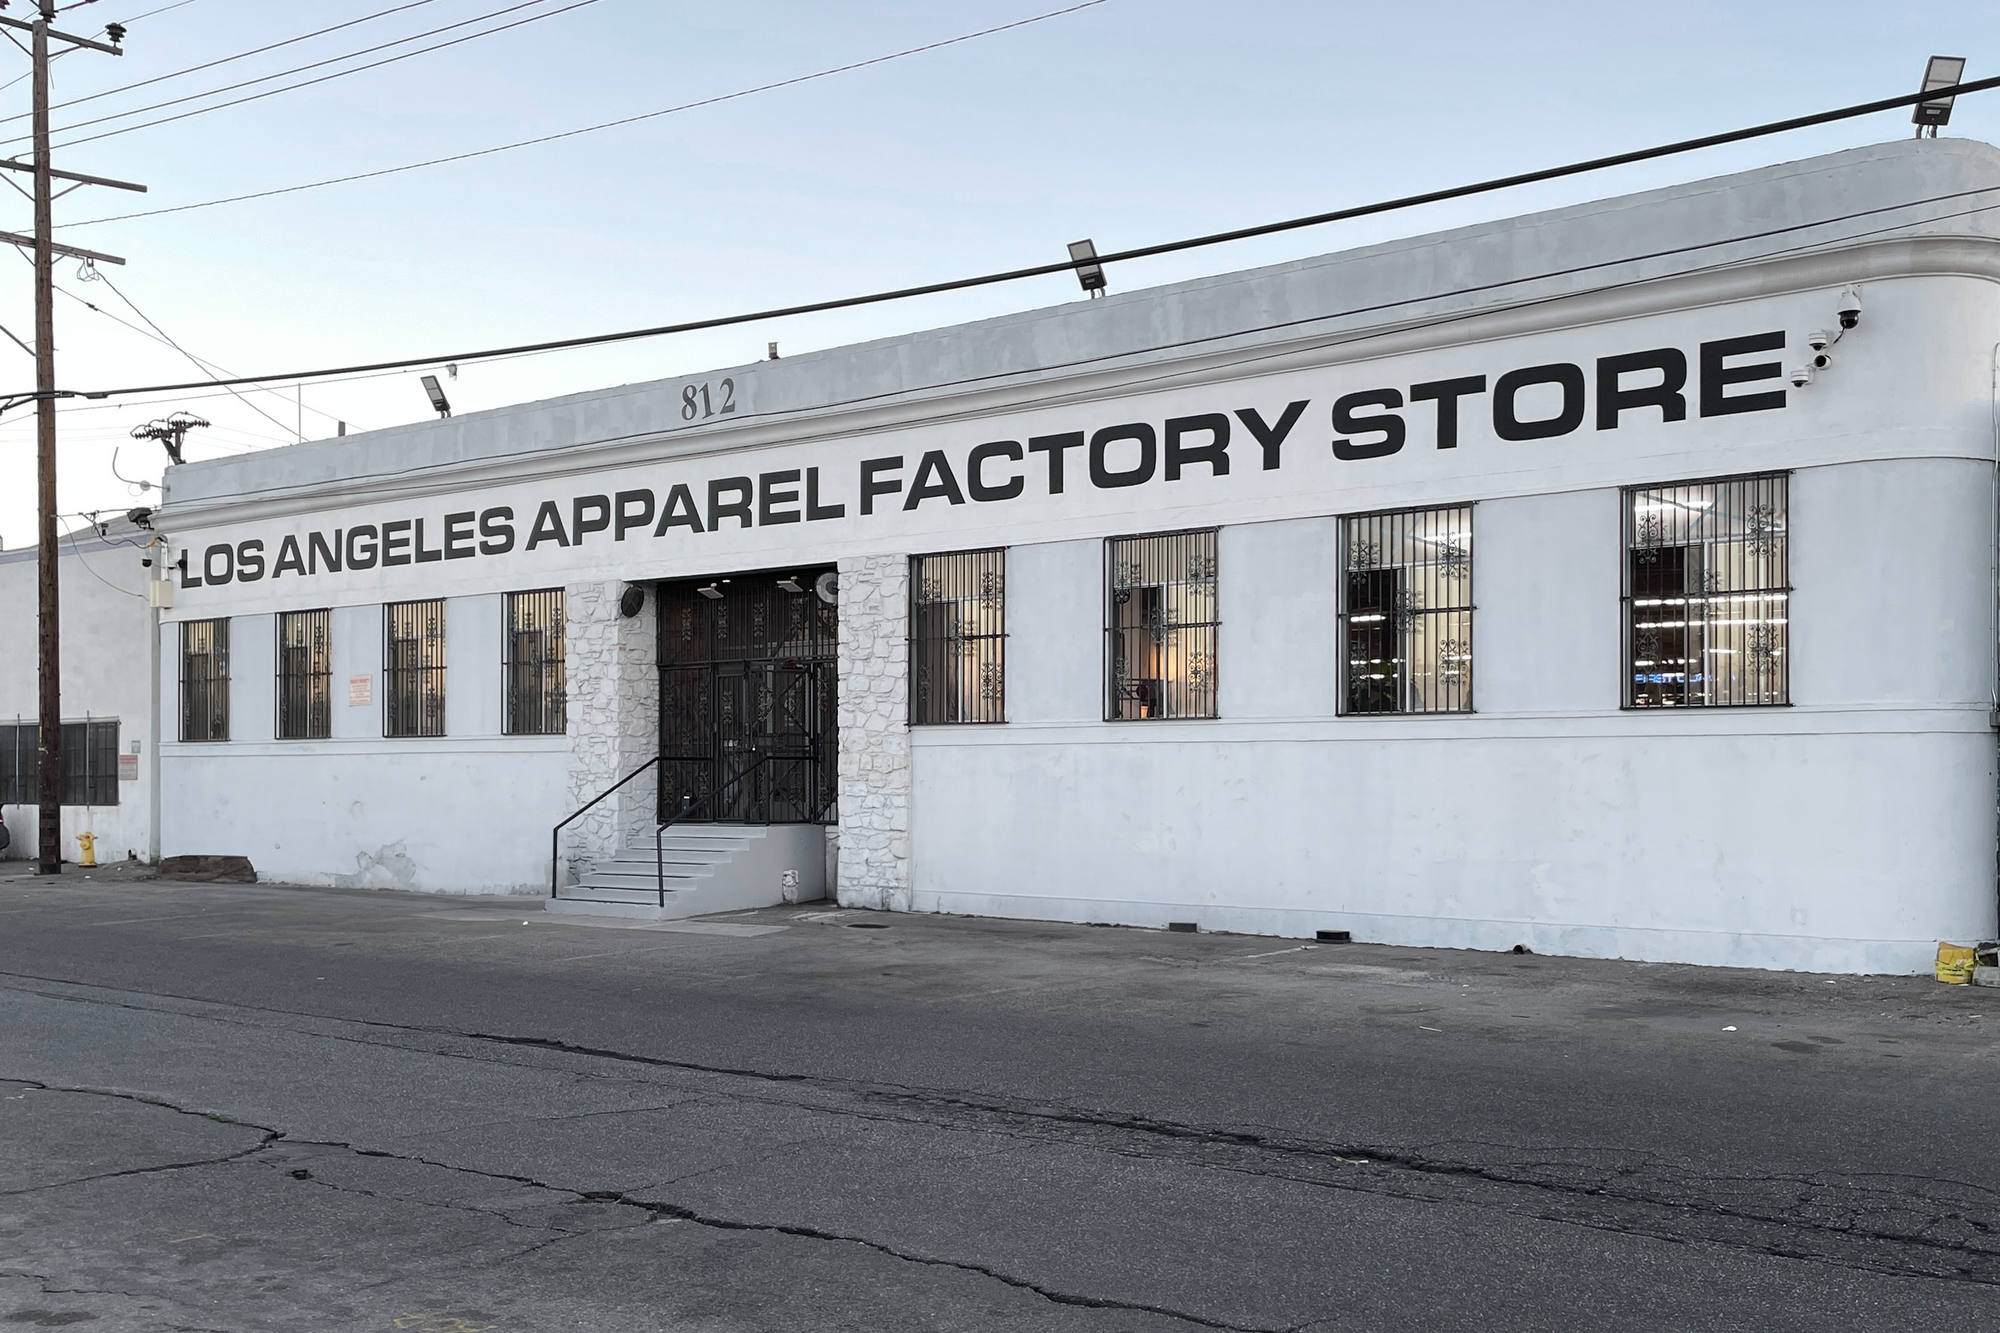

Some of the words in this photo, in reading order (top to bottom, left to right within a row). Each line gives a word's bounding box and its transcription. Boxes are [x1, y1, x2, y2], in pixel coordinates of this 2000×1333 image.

[180, 539, 264, 589] LOS
[271, 506, 515, 578] ANGELES
[525, 466, 845, 551] APPAREL
[860, 399, 1310, 516] FACTORY
[1332, 329, 1787, 460] STORE
[681, 377, 735, 420] 812
